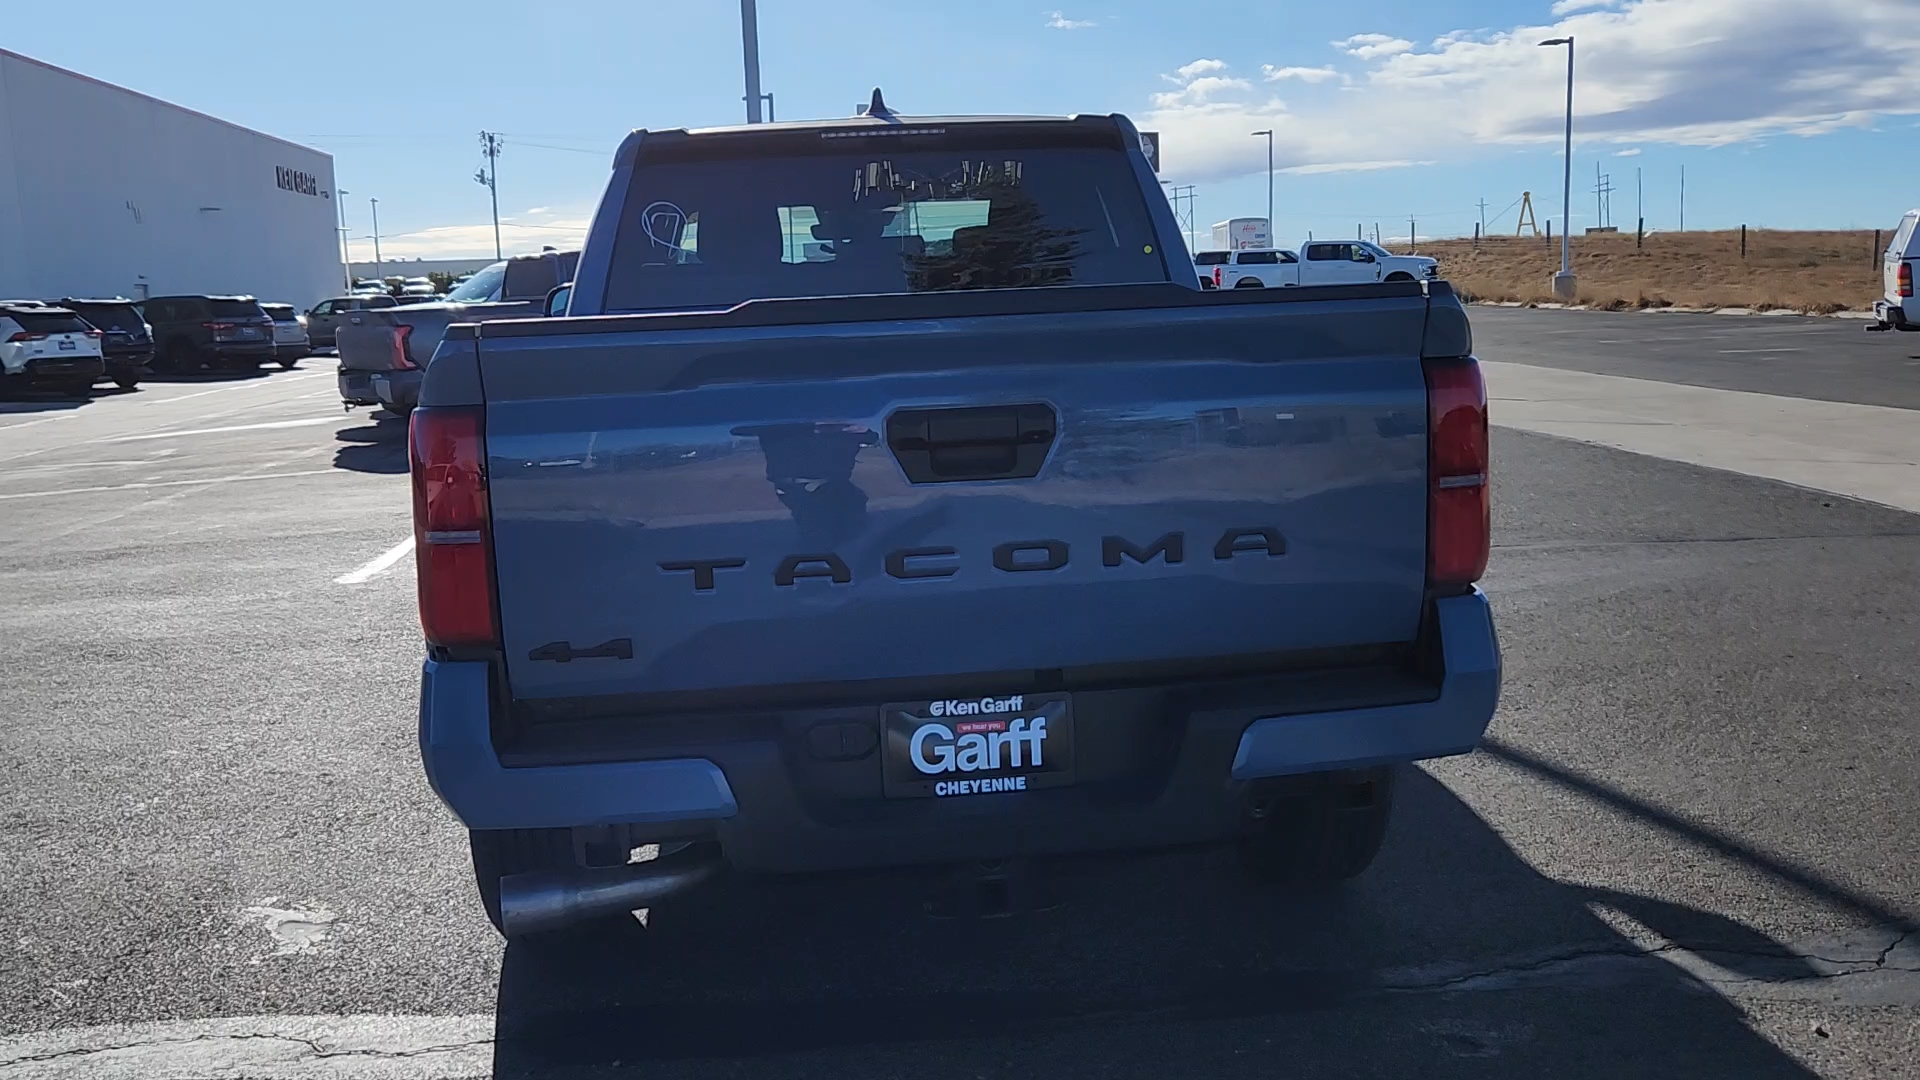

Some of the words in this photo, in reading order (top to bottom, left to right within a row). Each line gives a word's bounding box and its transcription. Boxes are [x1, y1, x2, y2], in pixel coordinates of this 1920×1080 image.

[656, 526, 1288, 591] TACOMA
[945, 700, 979, 716] Ken
[980, 695, 1023, 713] Garff
[910, 717, 1047, 774] Garff
[935, 776, 1027, 796] CHEYENNE
